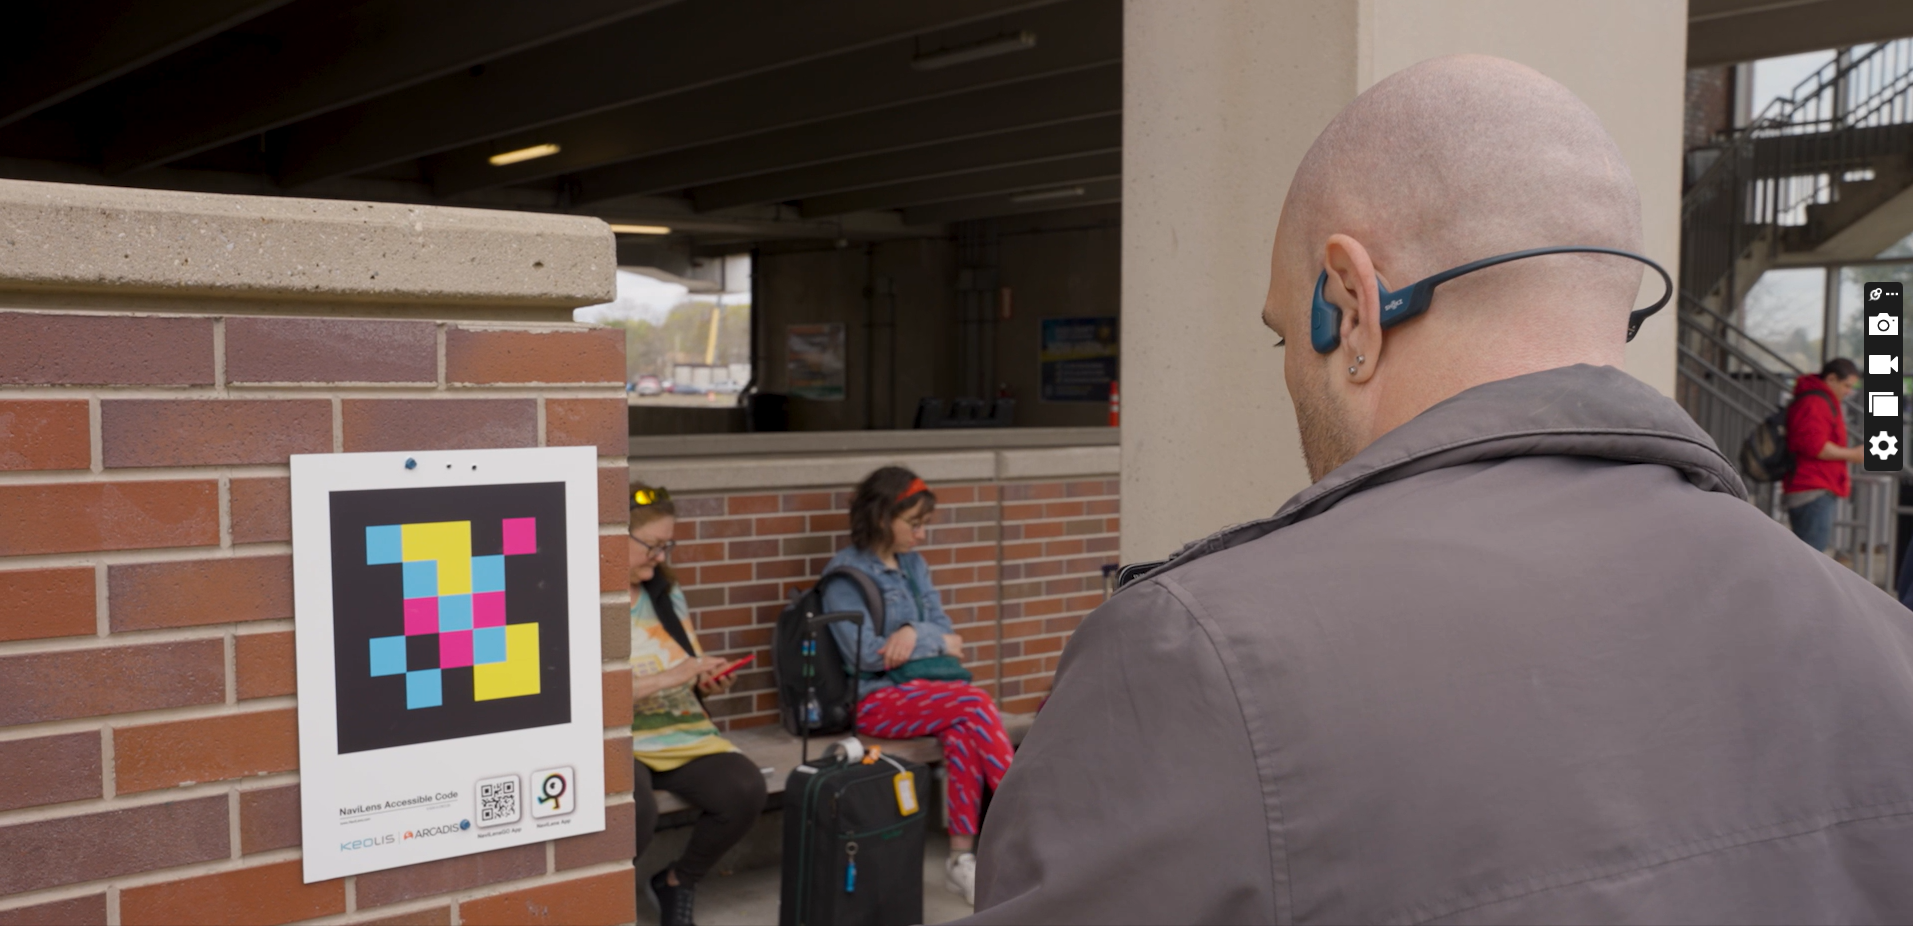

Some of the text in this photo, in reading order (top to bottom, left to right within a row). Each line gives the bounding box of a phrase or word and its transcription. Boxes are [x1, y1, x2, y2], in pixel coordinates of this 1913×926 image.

[339, 803, 382, 816] NaviLens
[384, 794, 433, 809] Accessible
[435, 790, 459, 801] Code
[414, 823, 460, 839] ARCADIS
